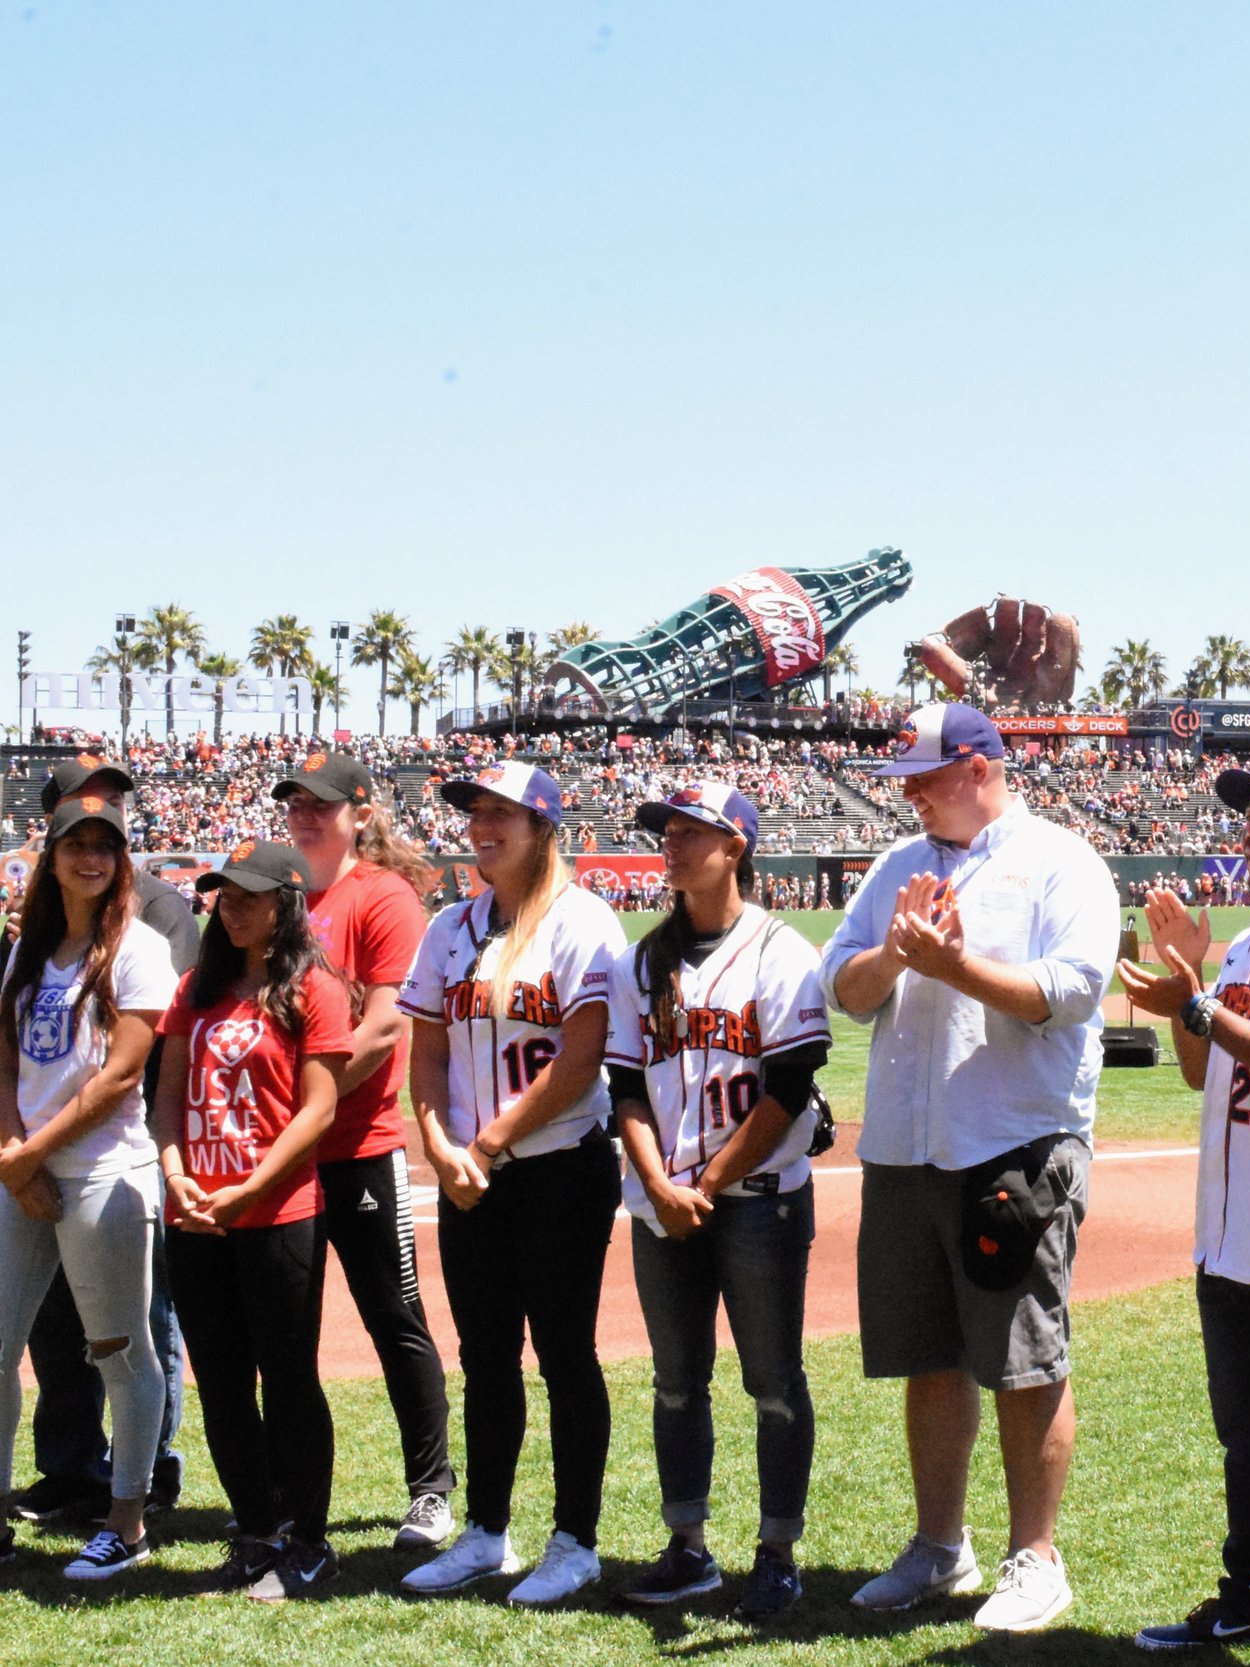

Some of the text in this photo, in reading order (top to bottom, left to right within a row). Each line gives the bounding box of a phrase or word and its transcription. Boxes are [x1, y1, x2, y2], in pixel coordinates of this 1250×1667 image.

[21, 672, 316, 714] nuveen
[1089, 720, 1124, 731] DECK
[444, 970, 563, 1028] TOMERS
[190, 1018, 205, 1065] I
[503, 1037, 556, 1094] 16
[188, 1067, 257, 1107] USA
[705, 1070, 758, 1129] 10
[188, 1109, 260, 1141] DEAF
[188, 1139, 259, 1176] WNT
